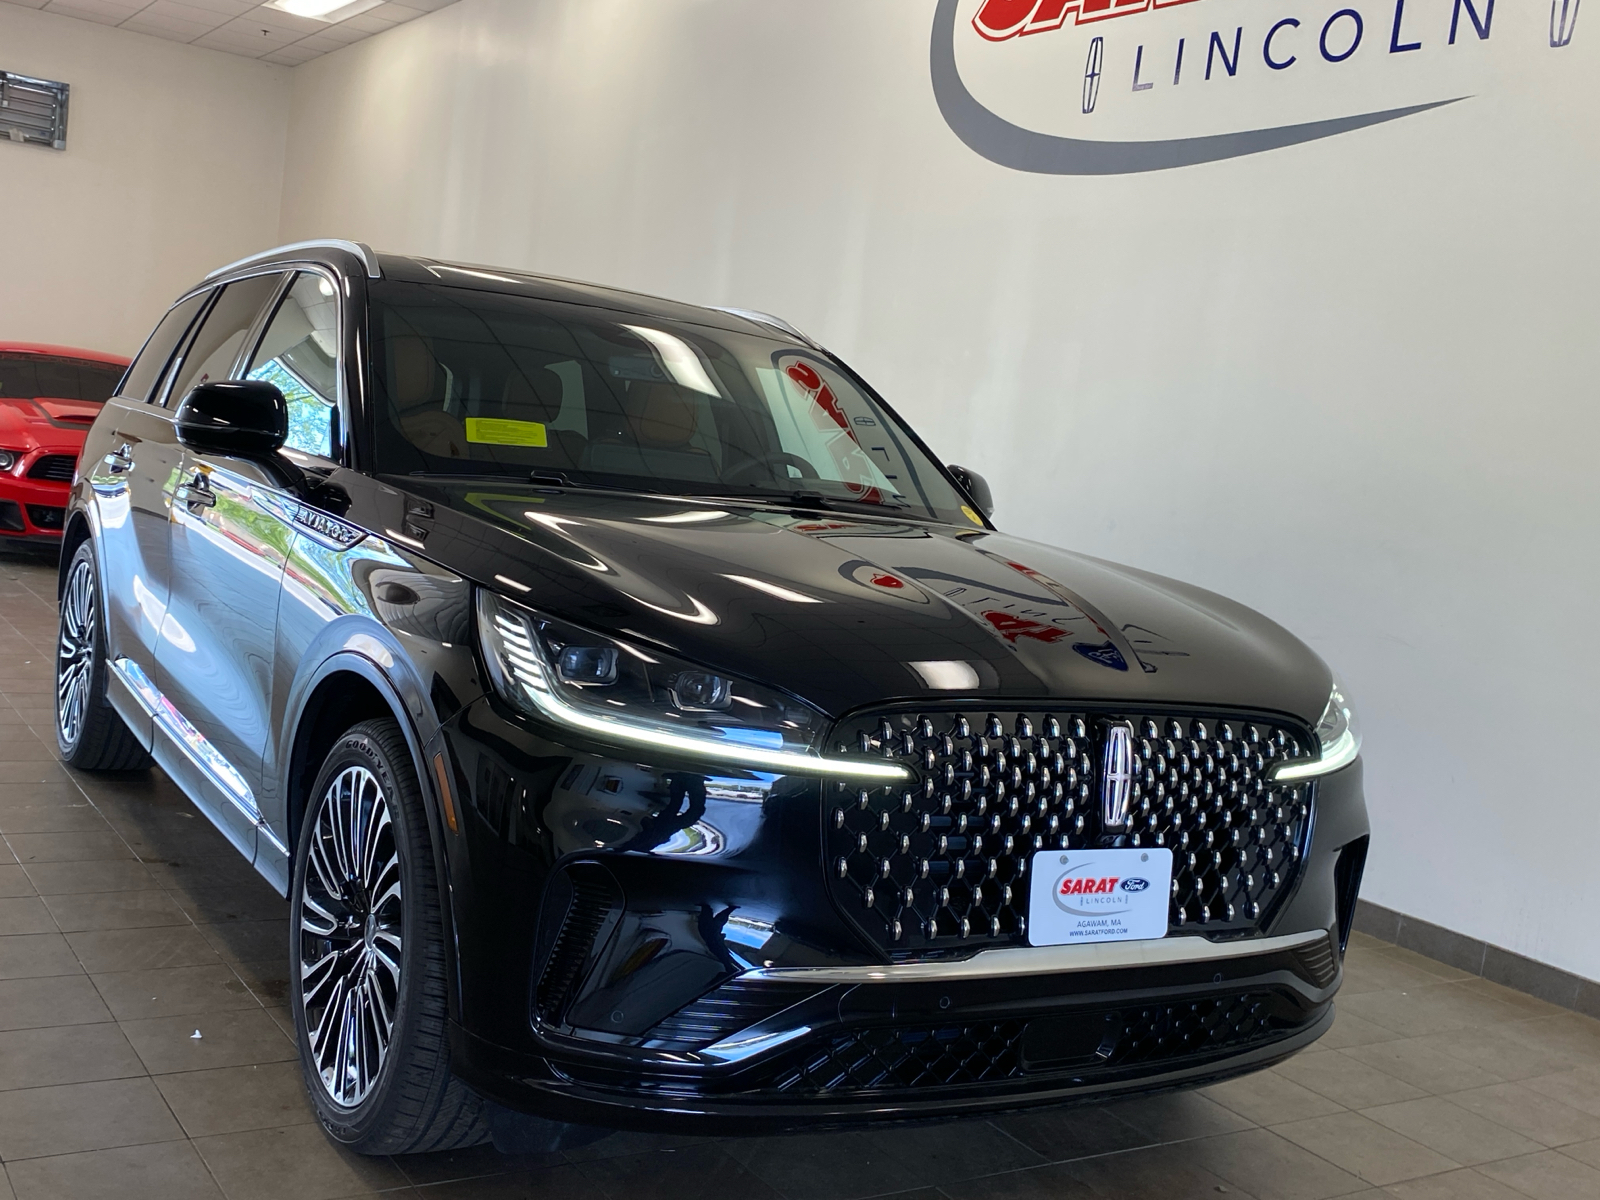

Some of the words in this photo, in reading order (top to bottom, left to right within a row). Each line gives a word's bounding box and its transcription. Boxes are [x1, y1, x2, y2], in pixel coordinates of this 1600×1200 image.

[1132, 0, 1495, 92] LINCOLN
[1060, 876, 1121, 895] SARAT
[1085, 897, 1122, 905] LINCOLN
[1076, 920, 1109, 928] AGAWAM,
[1110, 919, 1122, 927] MA
[1069, 928, 1128, 937] WWW.SARATFORD.COM
